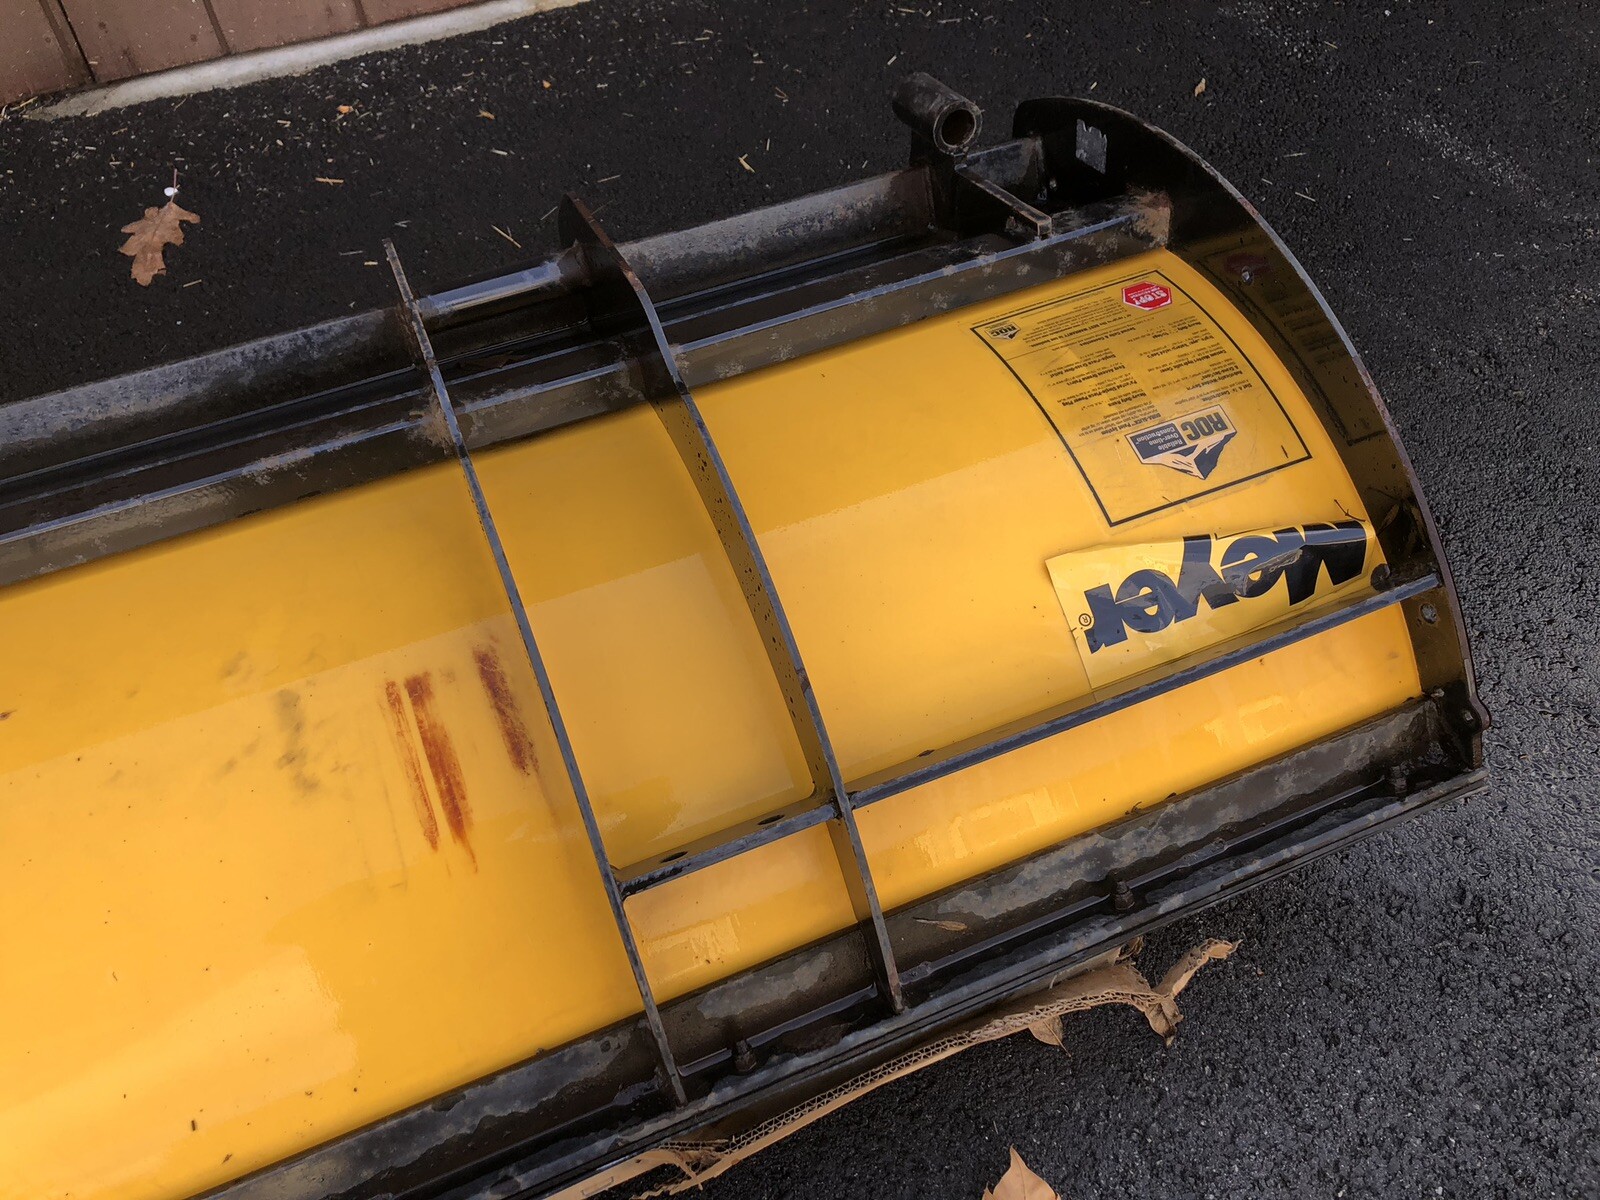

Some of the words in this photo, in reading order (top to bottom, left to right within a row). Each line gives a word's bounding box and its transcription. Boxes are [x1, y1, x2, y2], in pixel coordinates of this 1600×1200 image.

[1181, 412, 1228, 441] ROC
[1148, 432, 1179, 446] Over-time
[1157, 438, 1183, 451] Reliable
[1083, 520, 1368, 654] Meyer
